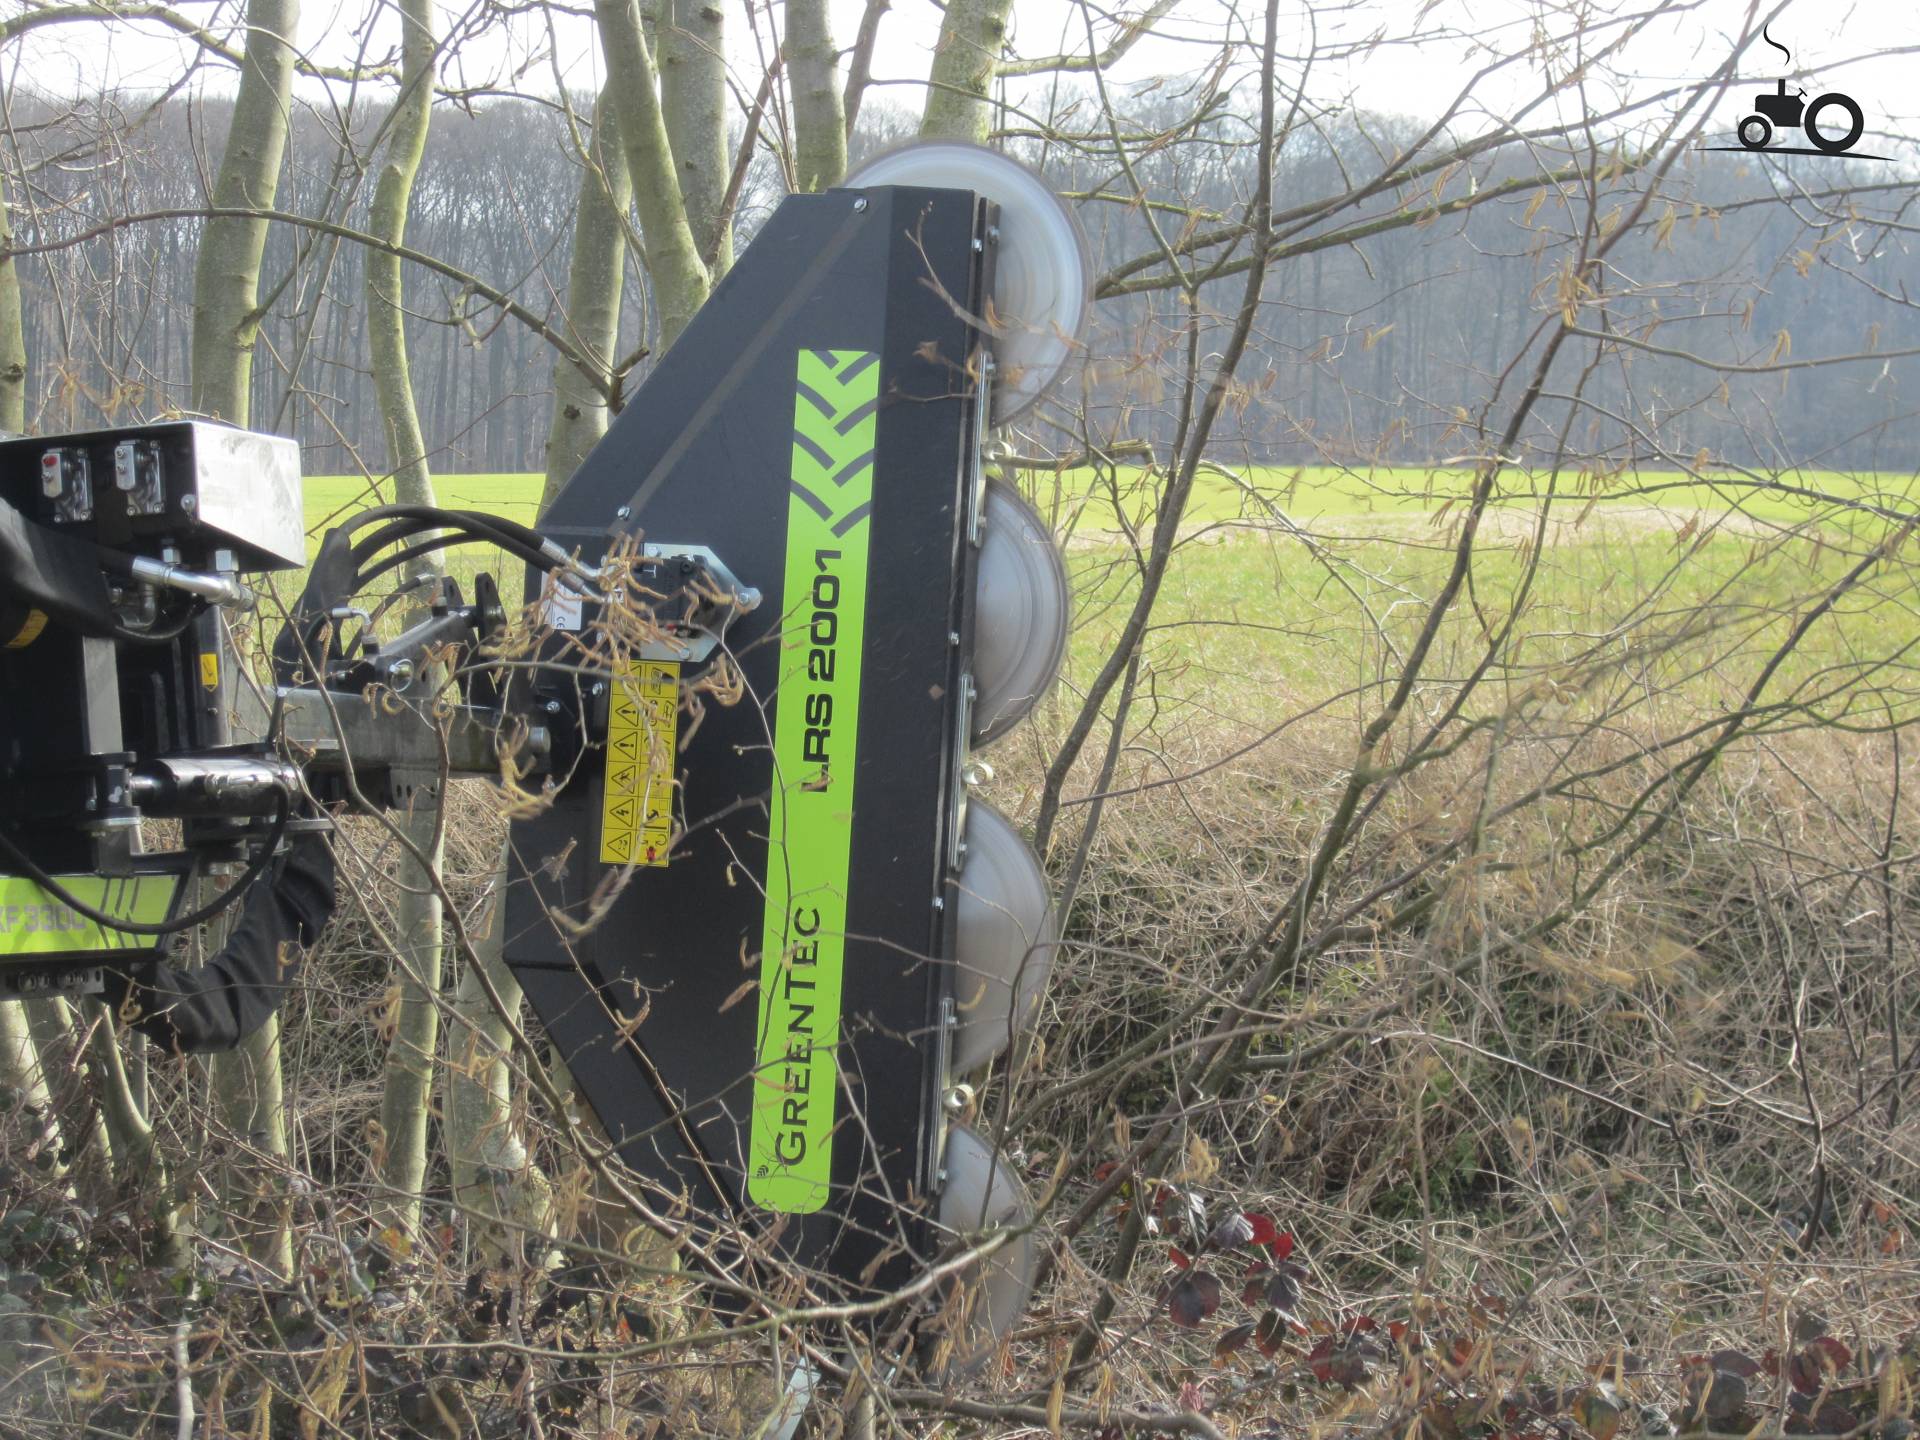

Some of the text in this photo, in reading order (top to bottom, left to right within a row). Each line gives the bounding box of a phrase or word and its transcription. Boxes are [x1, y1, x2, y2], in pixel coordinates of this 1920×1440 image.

[801, 549, 841, 792] LRS 2001
[775, 907, 821, 1167] GREENTEC
